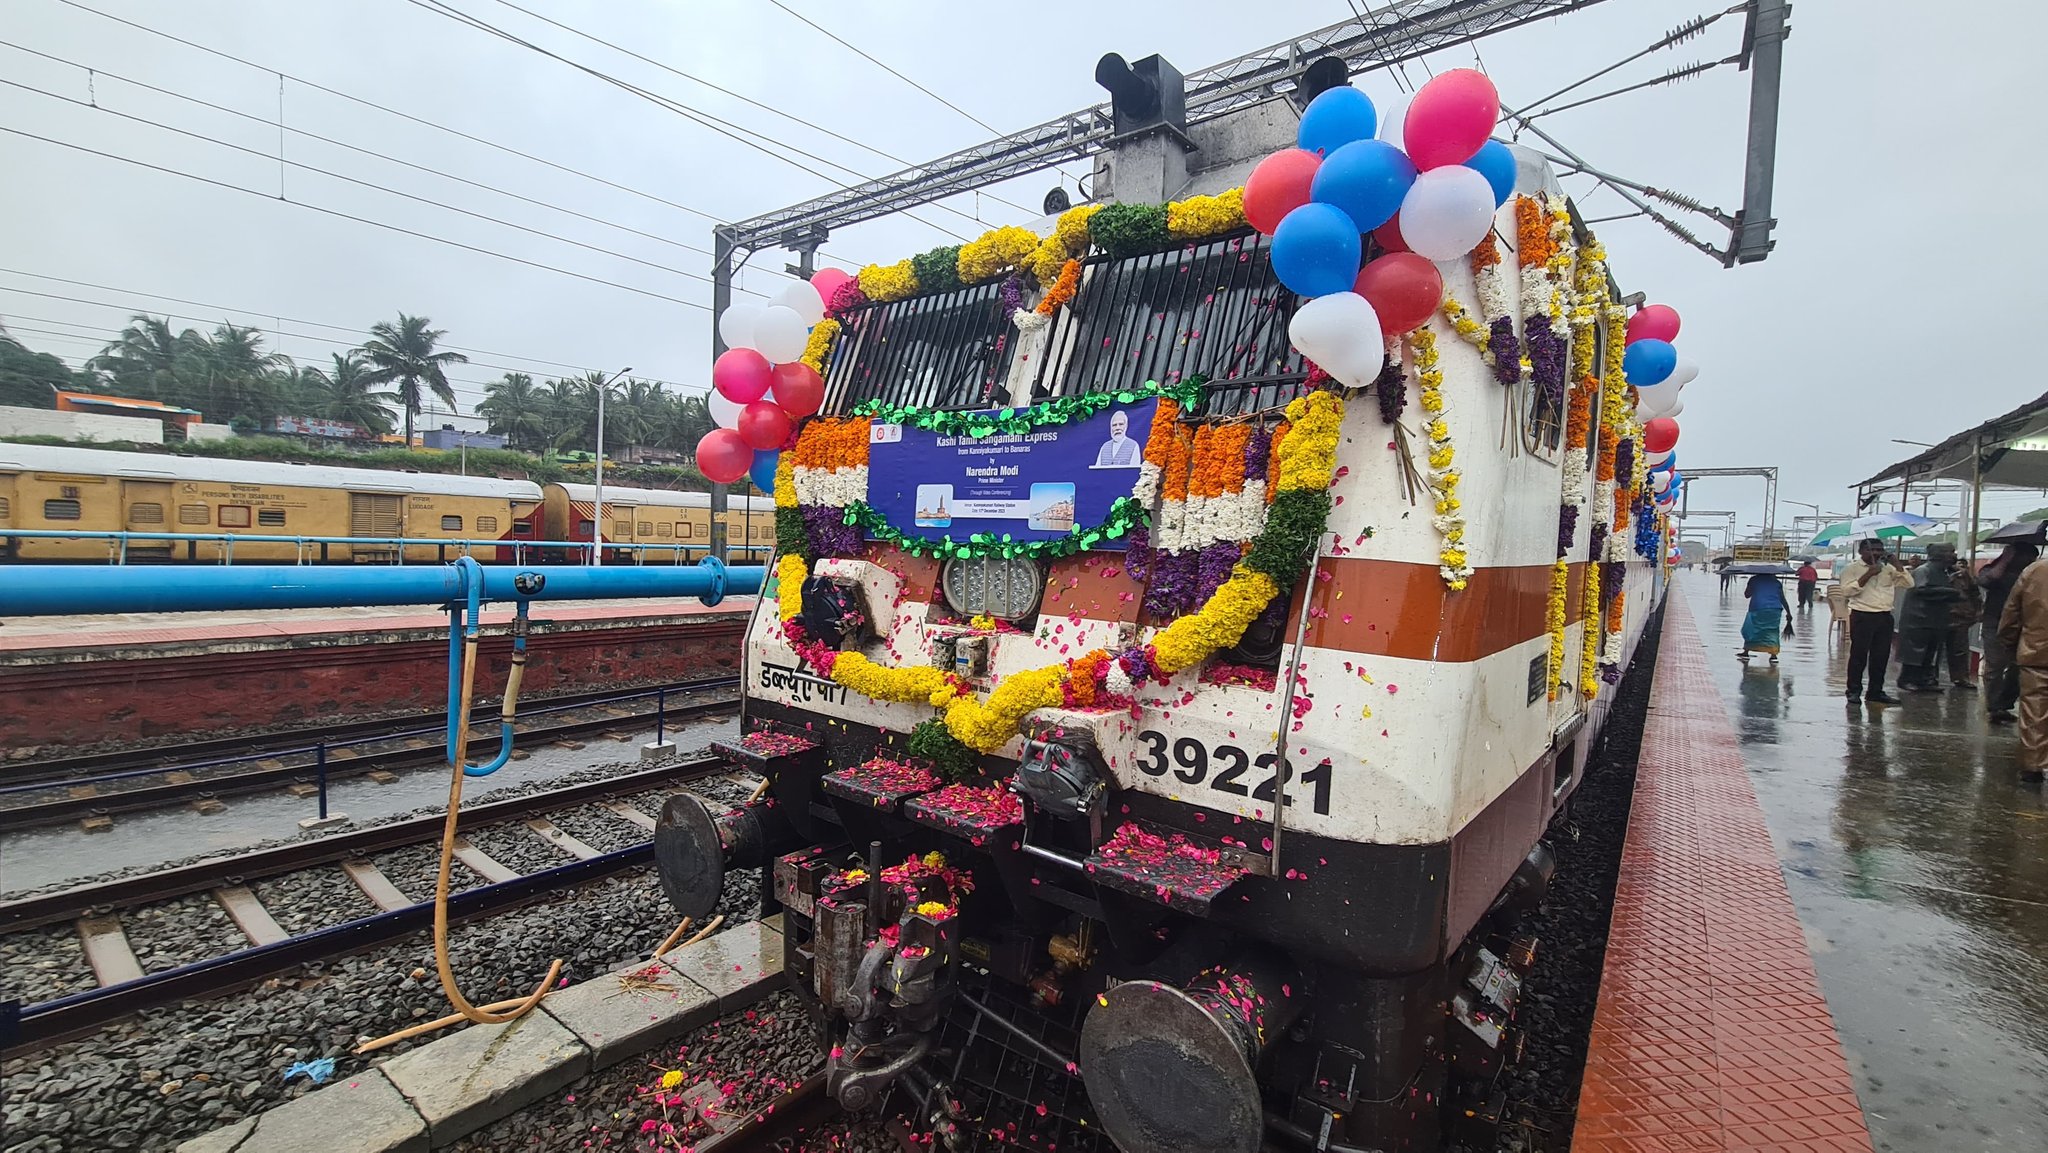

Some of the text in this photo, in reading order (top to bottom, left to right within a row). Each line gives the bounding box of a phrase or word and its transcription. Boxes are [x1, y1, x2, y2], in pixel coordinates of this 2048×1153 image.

[936, 436, 956, 447] Kashi
[1024, 431, 1058, 443] Express
[966, 465, 1019, 476] Narendra Modi
[979, 685, 991, 694] BUS
[1136, 730, 1332, 816] 39221
